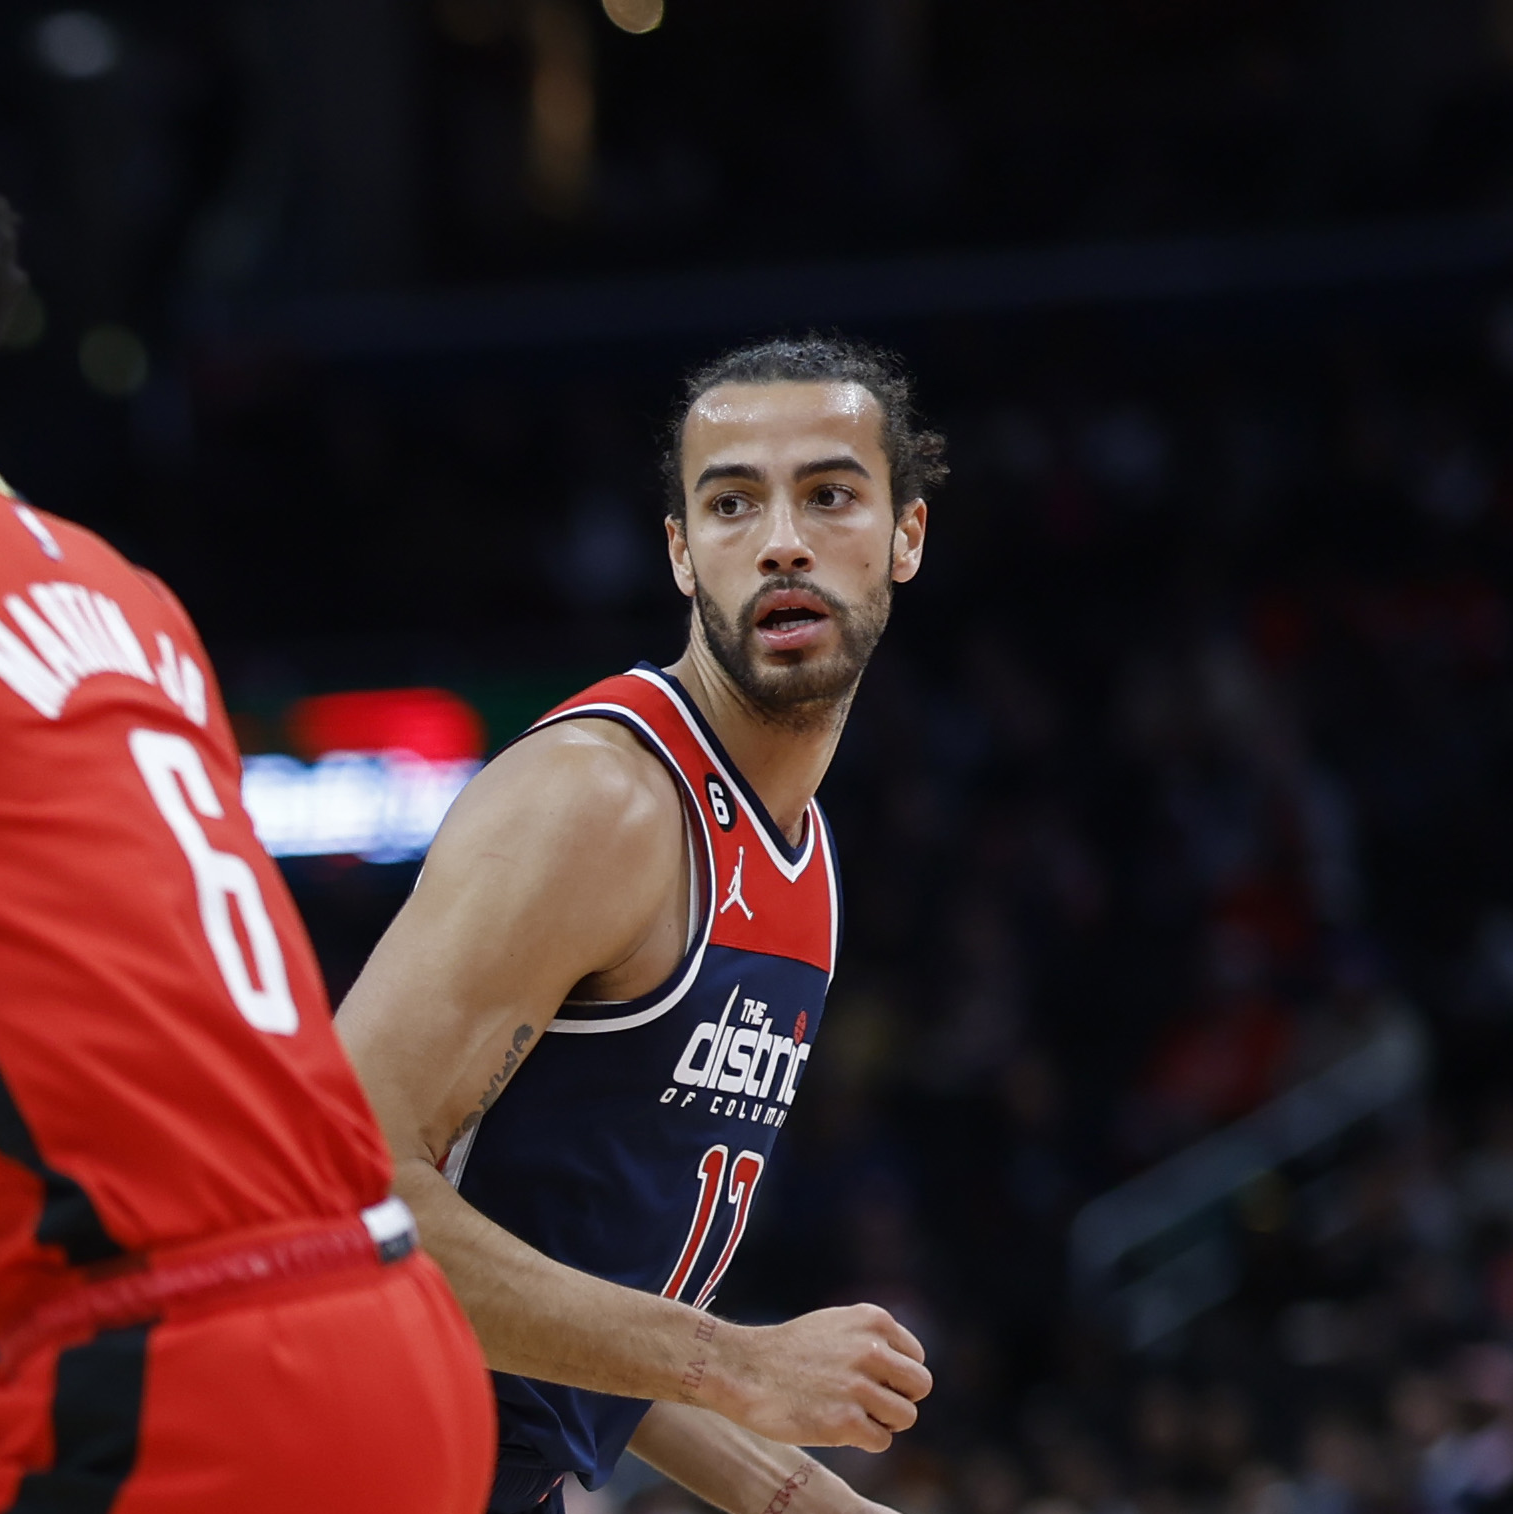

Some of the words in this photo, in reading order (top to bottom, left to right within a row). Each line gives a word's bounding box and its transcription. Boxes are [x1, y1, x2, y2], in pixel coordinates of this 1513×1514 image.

[708, 781, 731, 825] 6
[128, 727, 300, 1037] 6
[739, 997, 769, 1026] THE
[672, 983, 812, 1107] distric
[658, 1086, 697, 1109] OF
